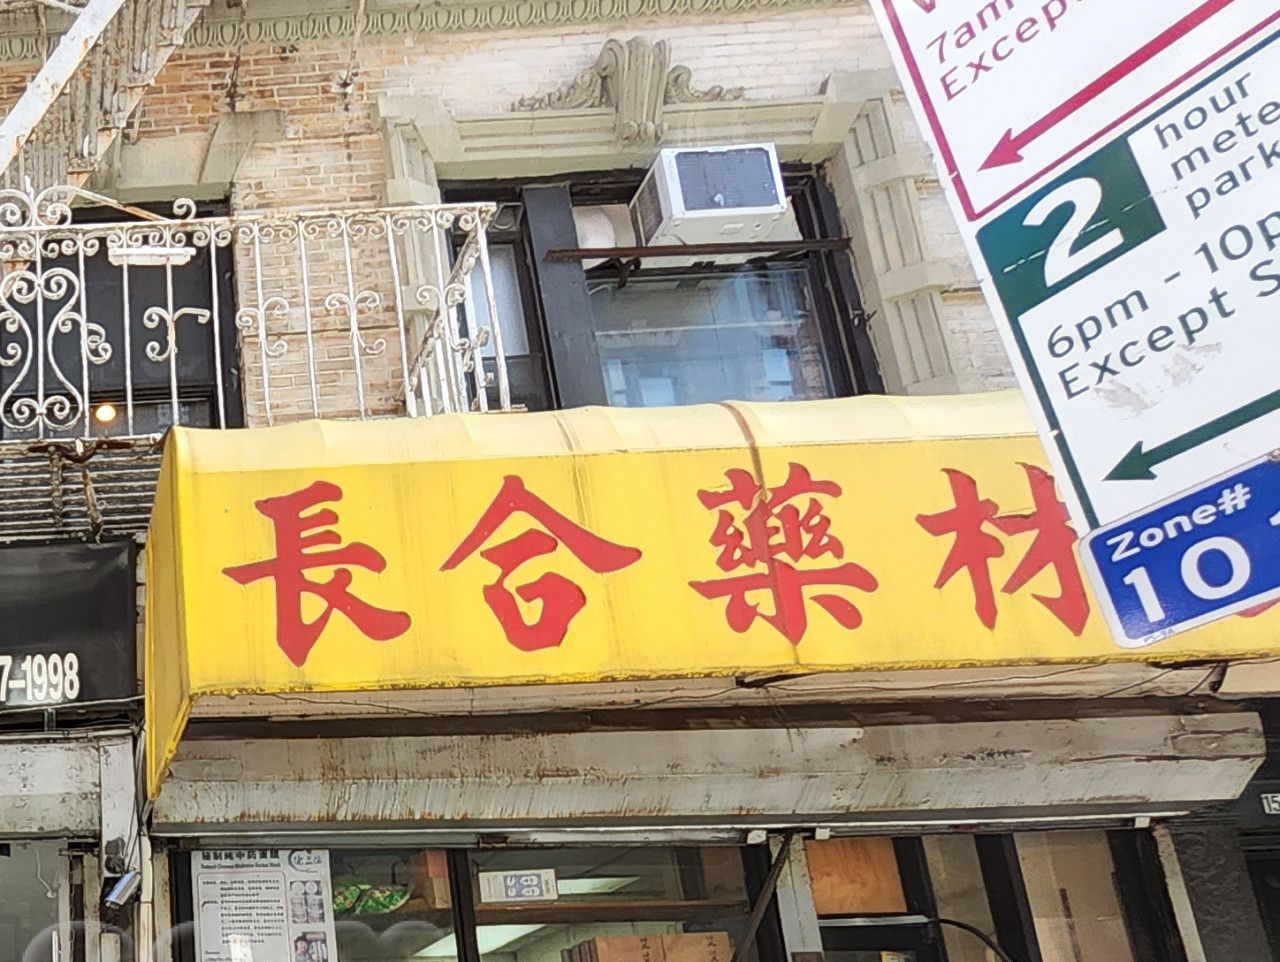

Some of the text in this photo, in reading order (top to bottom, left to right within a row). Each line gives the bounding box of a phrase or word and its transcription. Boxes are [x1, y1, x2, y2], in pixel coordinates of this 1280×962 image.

[940, 0, 1080, 102] Excep
[1154, 72, 1252, 149] hour
[1022, 177, 1124, 288] 2
[1047, 290, 1149, 358] 6pm
[1058, 287, 1236, 400] Except
[222, 462, 1280, 668] 長合藥材
[1106, 483, 1252, 562] Zone#
[1123, 511, 1280, 623] 10
